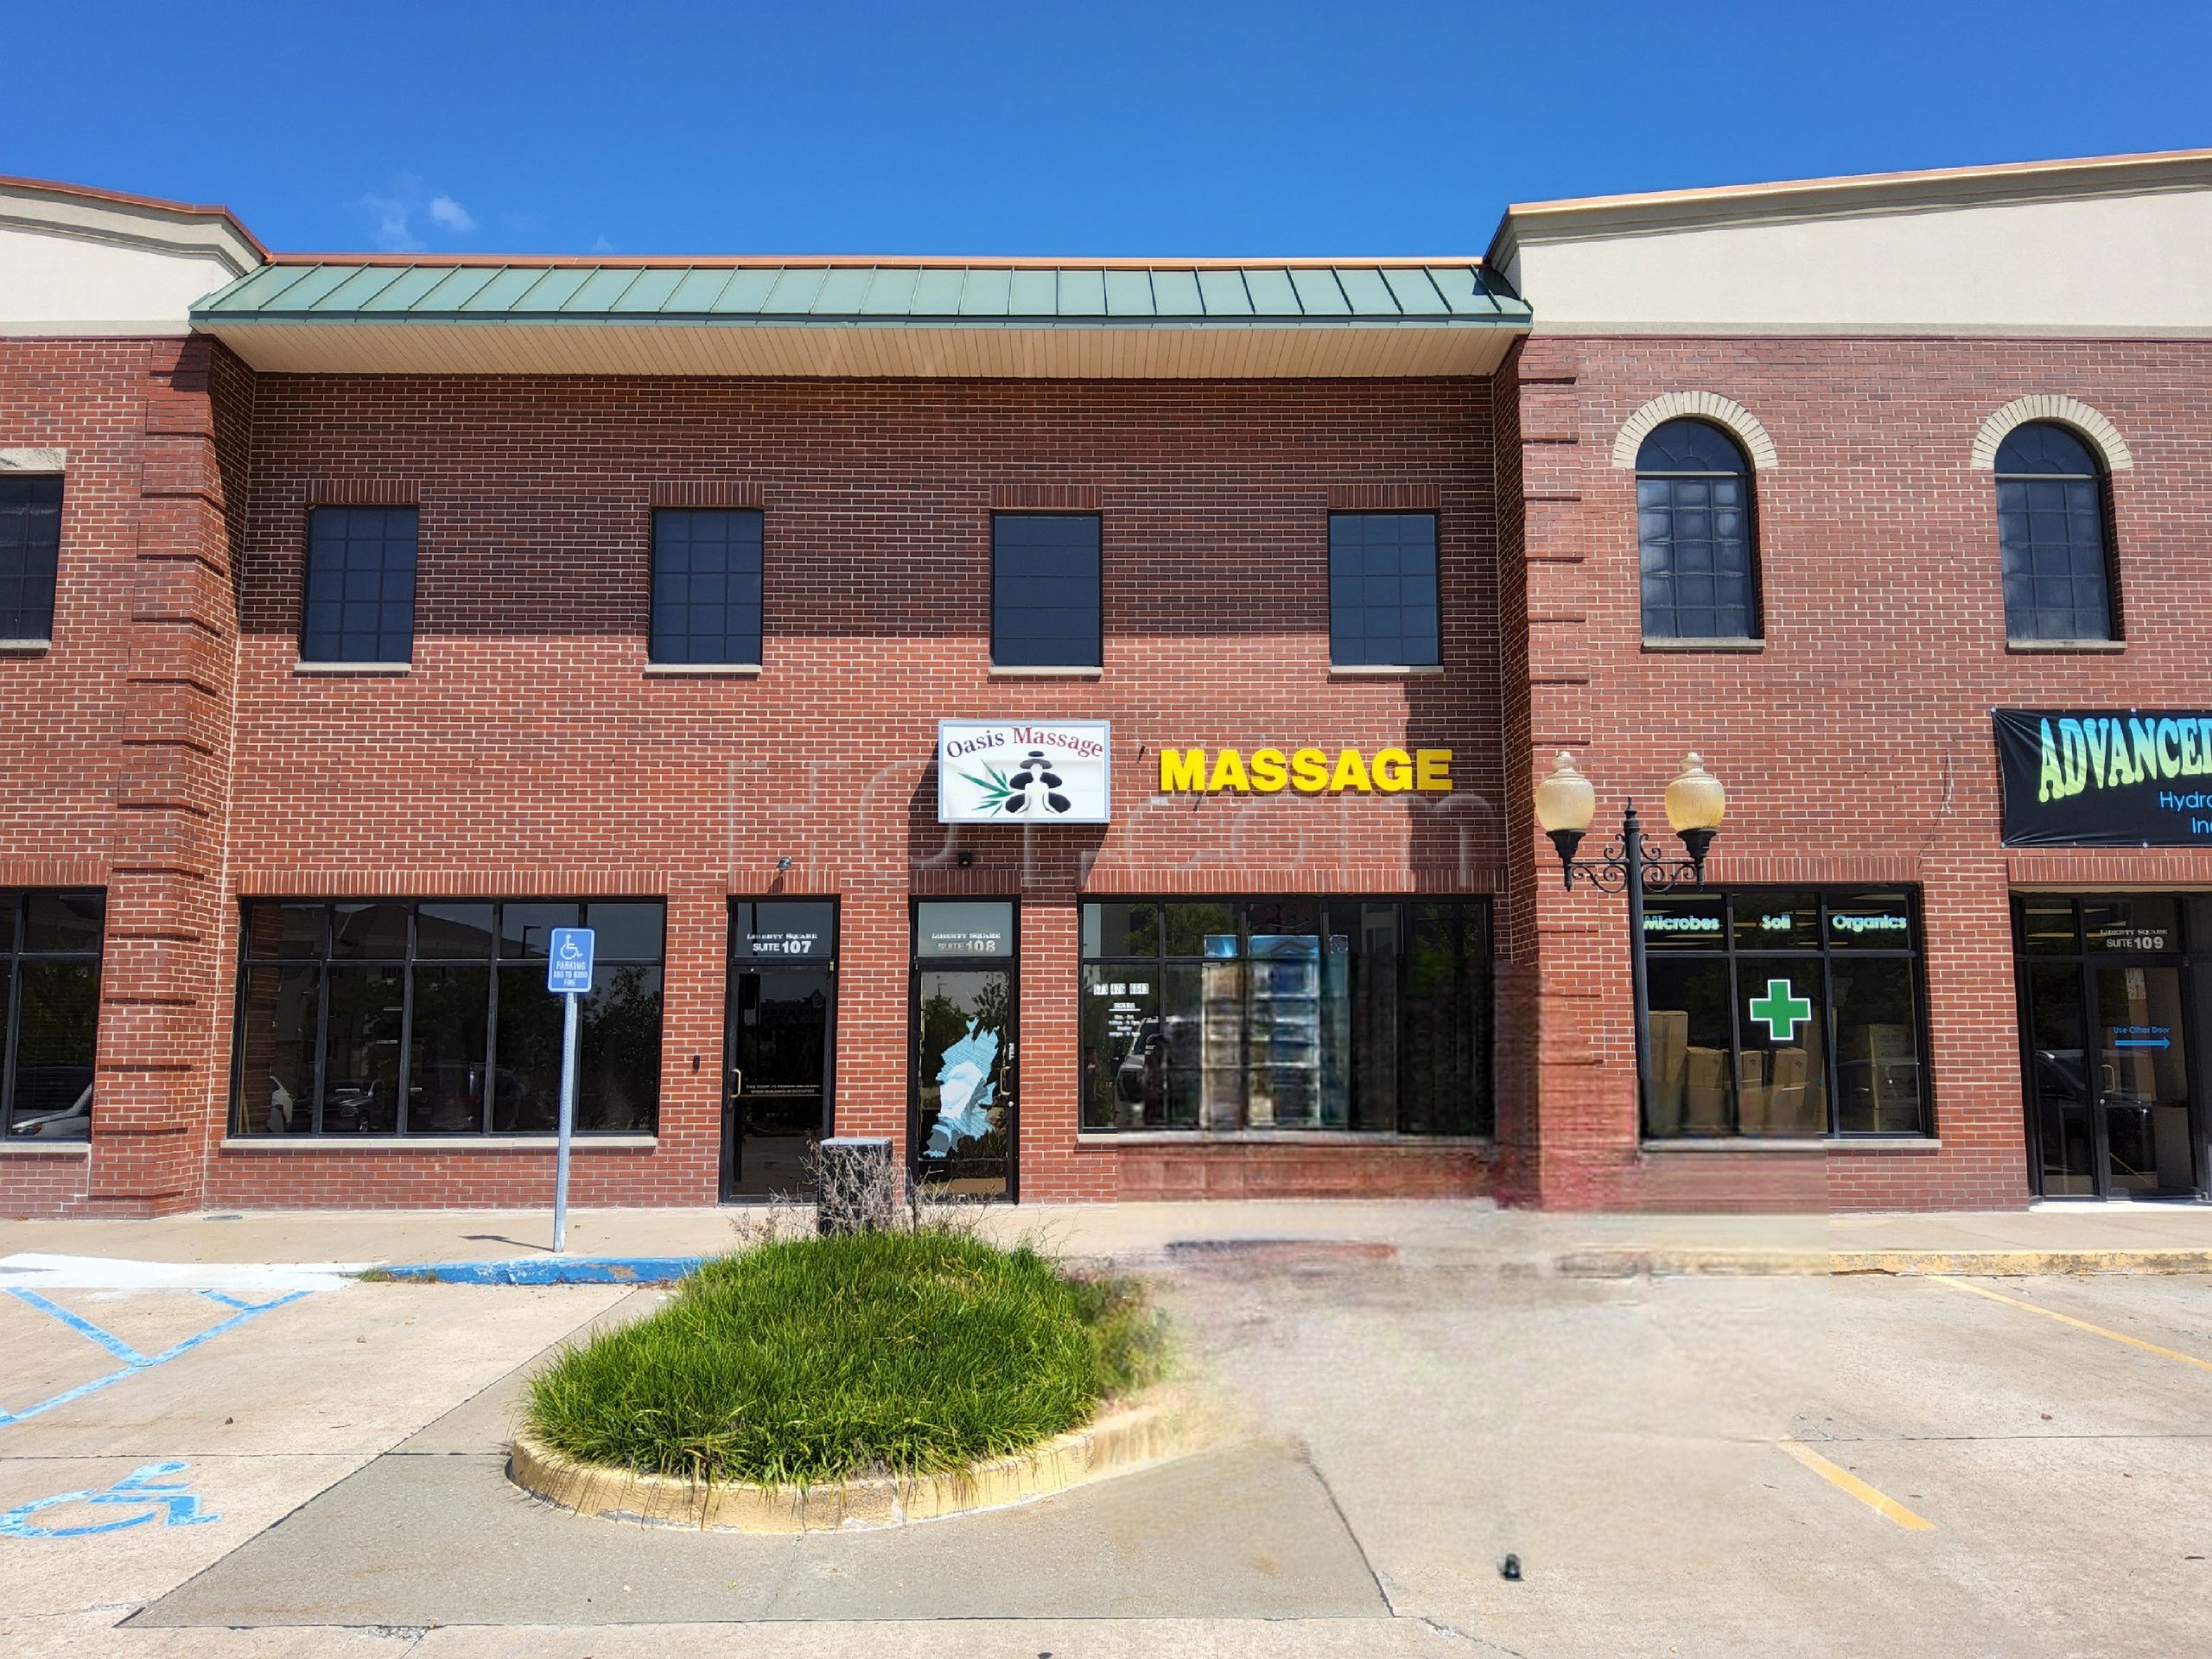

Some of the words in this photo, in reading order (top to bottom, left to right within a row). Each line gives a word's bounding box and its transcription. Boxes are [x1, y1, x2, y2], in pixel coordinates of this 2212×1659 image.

[947, 730, 1005, 758] Oasis
[1011, 727, 1103, 758] Massage
[1160, 748, 1452, 791] MASSAGE
[2192, 817, 2212, 834] In
[1643, 915, 1719, 931] Microbes
[1762, 914, 1790, 930] Soil
[1832, 914, 1907, 932] Organics
[782, 940, 811, 954] 107
[966, 940, 995, 952] 108
[2107, 939, 2133, 948] SUITE
[2134, 937, 2164, 949] 109
[556, 961, 586, 970] PARKING
